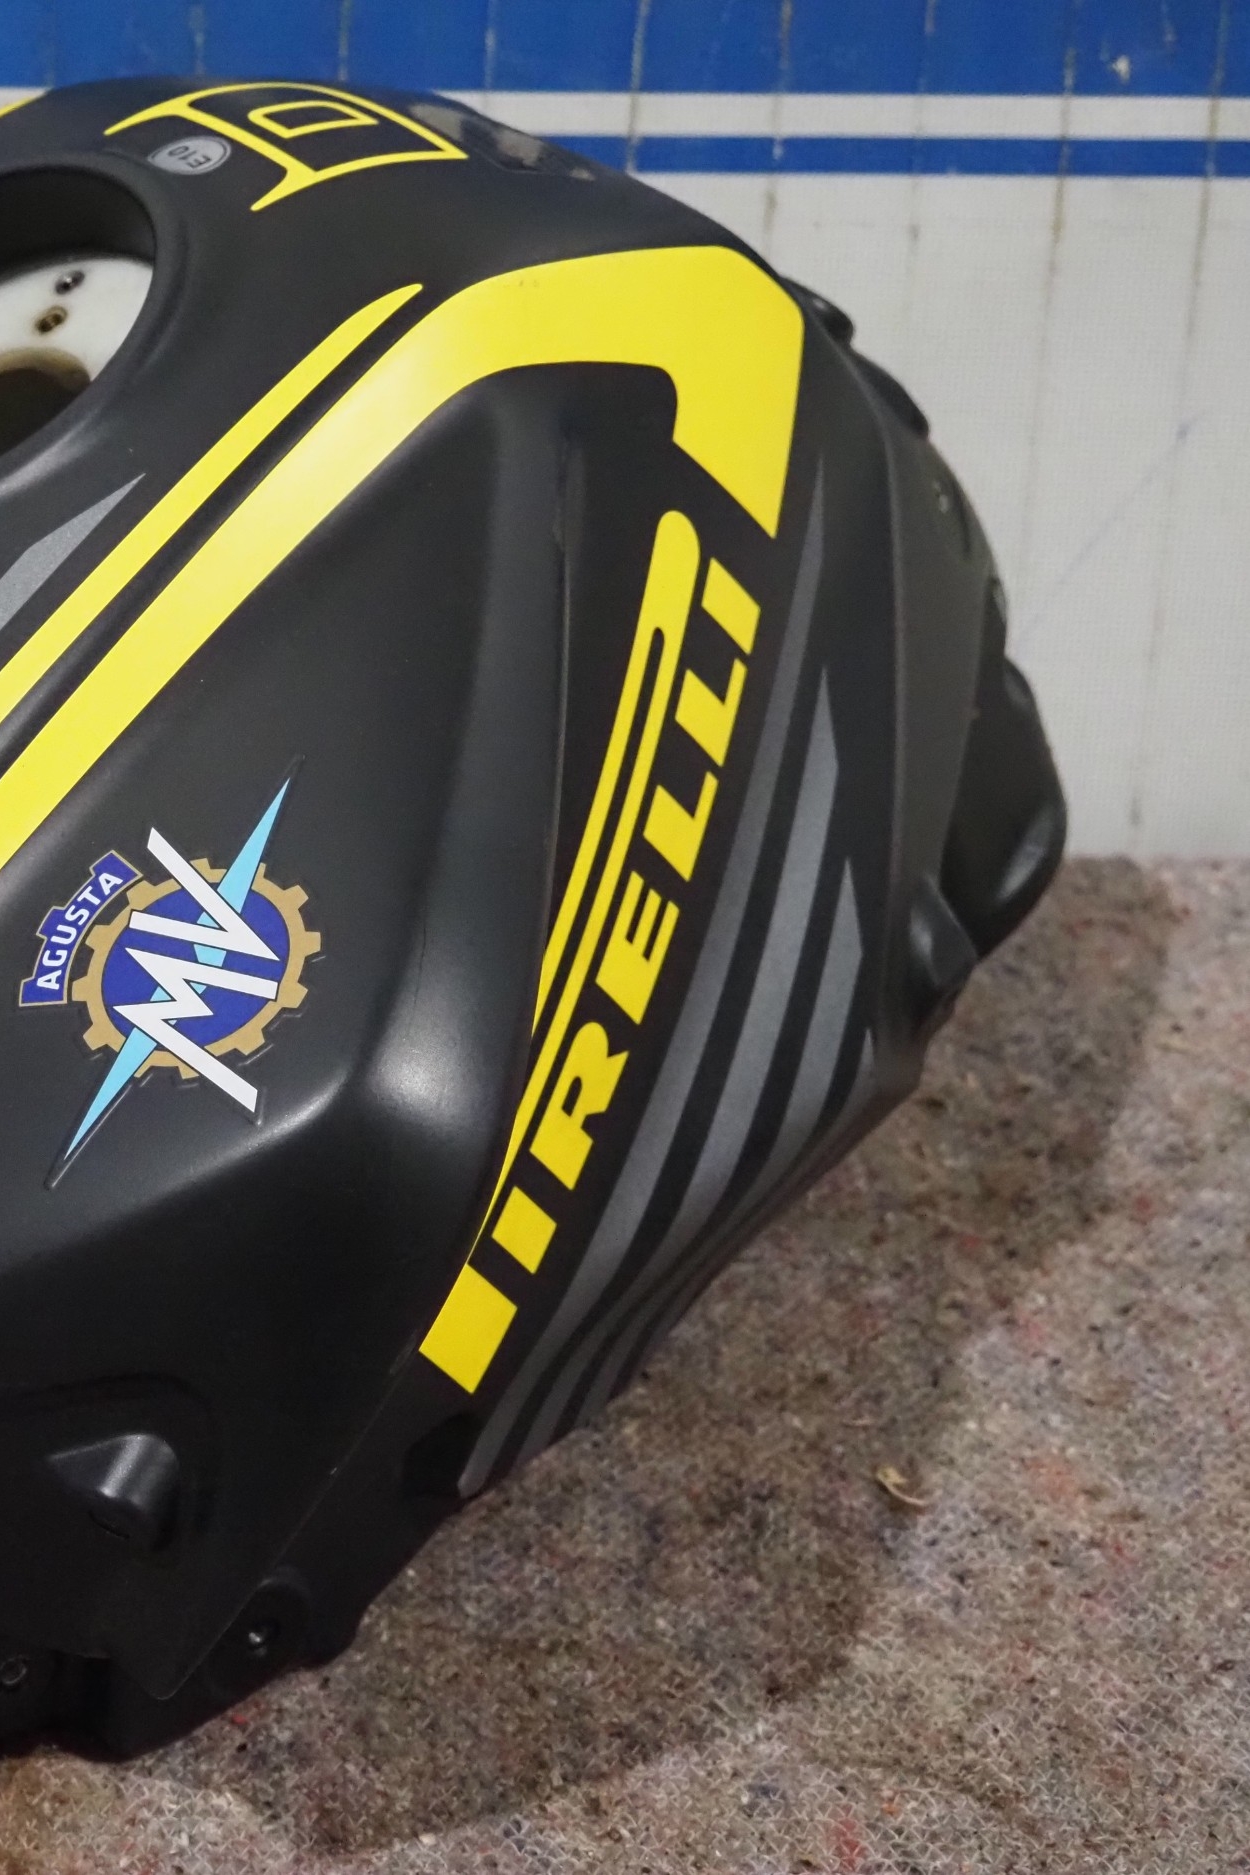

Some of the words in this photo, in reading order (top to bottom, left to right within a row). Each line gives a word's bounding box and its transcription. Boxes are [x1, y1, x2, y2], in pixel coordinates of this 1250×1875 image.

[167, 146, 212, 169] E10
[36, 871, 124, 990] AGUSTA
[112, 826, 281, 1113] MV
[419, 510, 760, 1393] PIRELLI
